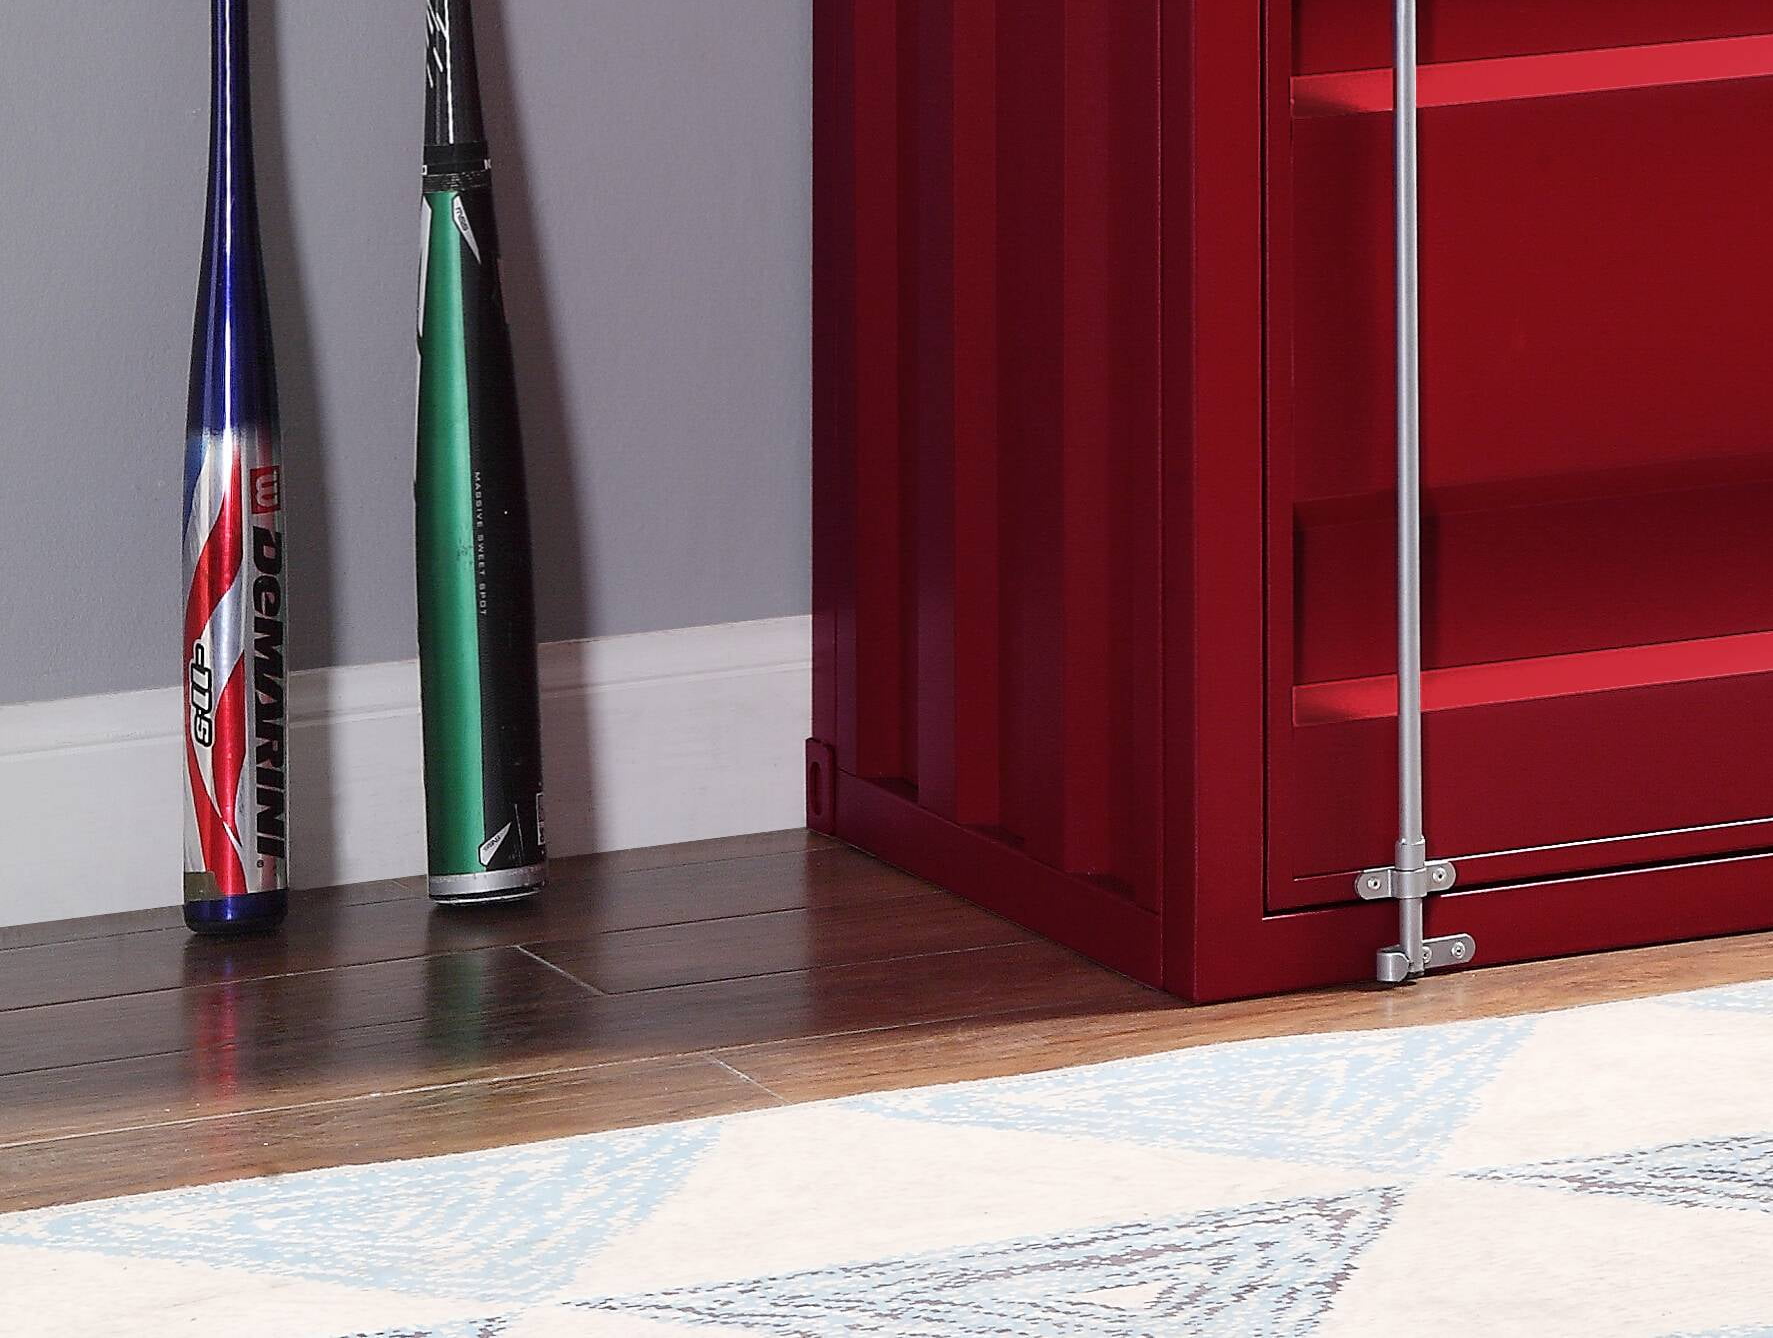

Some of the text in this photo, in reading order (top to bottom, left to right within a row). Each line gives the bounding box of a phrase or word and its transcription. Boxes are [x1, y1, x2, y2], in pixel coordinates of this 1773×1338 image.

[474, 471, 487, 616] MASSIVE SWEET SPOT
